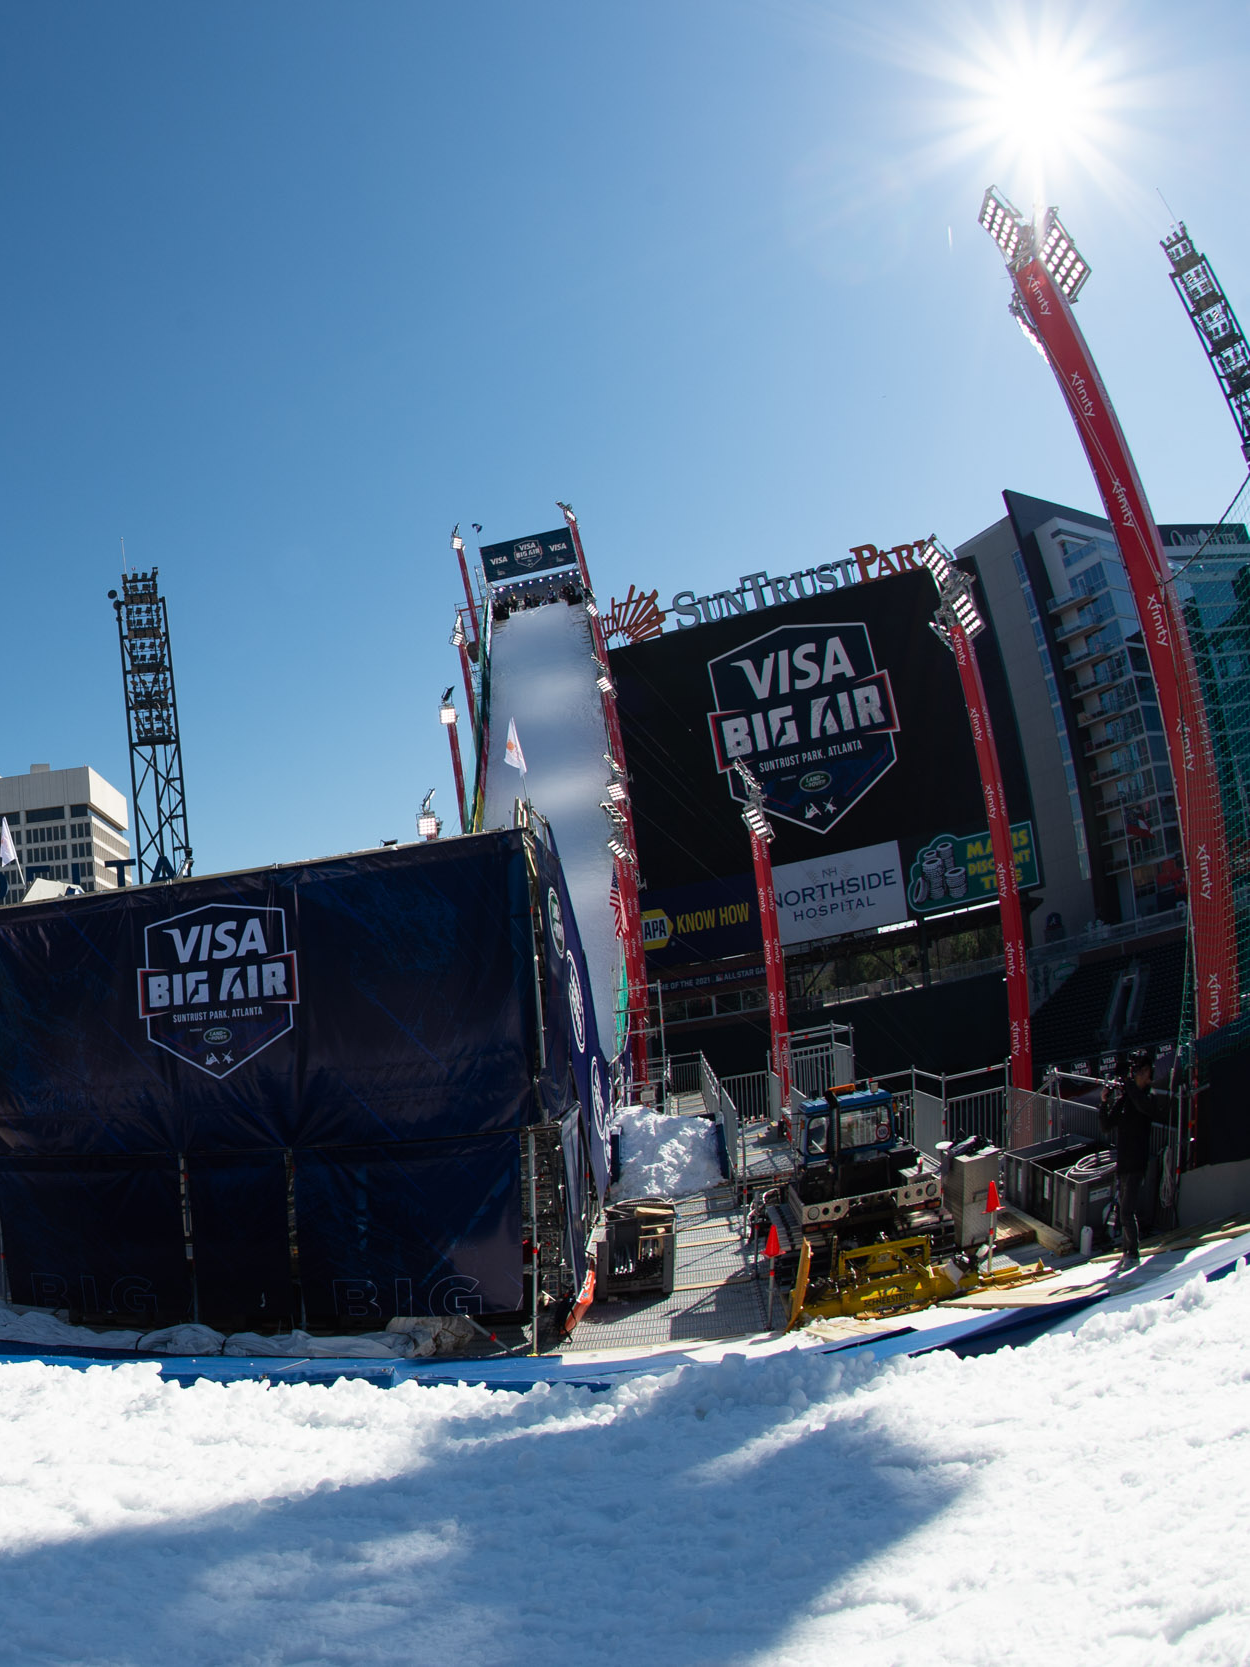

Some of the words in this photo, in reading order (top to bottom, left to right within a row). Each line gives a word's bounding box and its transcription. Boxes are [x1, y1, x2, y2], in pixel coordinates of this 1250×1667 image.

[1026, 273, 1052, 316] xfinity
[1071, 371, 1096, 418] xfinity
[1111, 477, 1134, 528] xfinity
[490, 555, 508, 566] VISA
[519, 542, 536, 551] VISA
[548, 542, 567, 552] VISA
[1146, 593, 1168, 647] xfinity
[954, 632, 966, 666] xfinity
[730, 636, 856, 700] VISA
[721, 705, 799, 759] BIG
[810, 684, 885, 739] AIR
[970, 707, 982, 742] xfinity
[759, 755, 799, 773] SUNTRUST
[828, 740, 863, 757] ATLANTA
[985, 784, 997, 819] xfinity
[751, 835, 759, 861] xfinity
[967, 830, 1029, 859] MAIS
[968, 849, 1031, 876] DISCNT
[1196, 843, 1212, 900] xfinity
[775, 869, 897, 908] NORTHSIDE
[996, 863, 1007, 898] xfinity
[758, 887, 766, 913] xfinity
[793, 896, 876, 922] HOSPITAL
[644, 918, 667, 940] APA
[676, 910, 716, 934] KNOW
[720, 903, 749, 926] HOW
[162, 918, 268, 964] VISA
[1017, 939, 1025, 975] xfinity
[1006, 941, 1015, 977] xfinity
[148, 971, 209, 1008] BIG
[219, 962, 288, 1001] AIR
[670, 982, 679, 990] OF
[680, 979, 693, 988] THE
[695, 976, 710, 986] 2021
[724, 972, 735, 981] ALL
[736, 968, 754, 978] STAR
[173, 1012, 207, 1023] SUNTRUST
[231, 1006, 263, 1018] ATLANTA
[1208, 972, 1221, 1029] xfinity
[1010, 1020, 1020, 1057] xfinity
[1102, 1056, 1115, 1064] VISA
[31, 1273, 157, 1314] BIG
[332, 1275, 482, 1317] BIG
